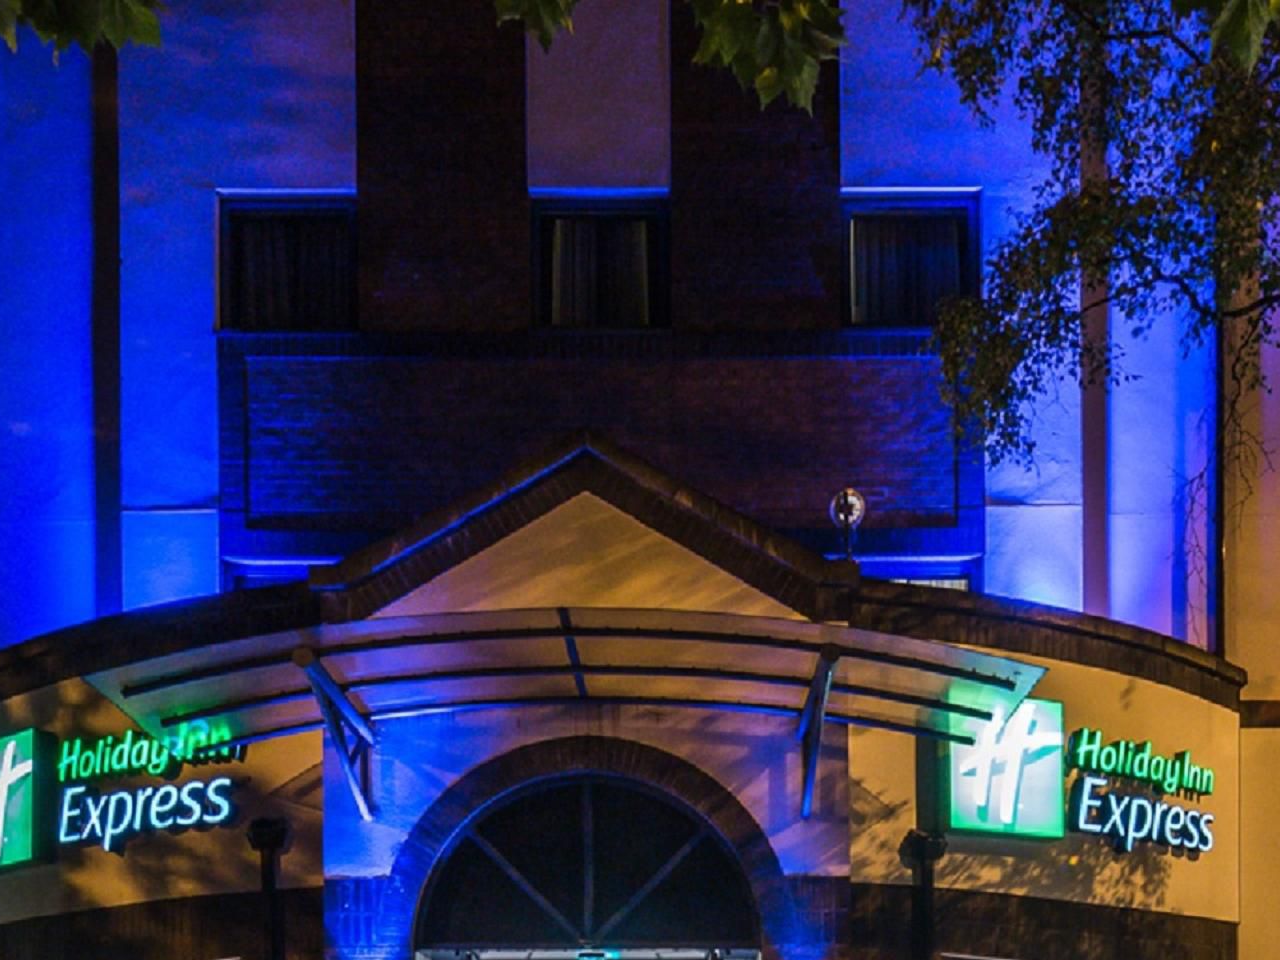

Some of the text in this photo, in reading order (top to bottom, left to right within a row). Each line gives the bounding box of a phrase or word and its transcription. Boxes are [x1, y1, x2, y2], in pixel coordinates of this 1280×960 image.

[57, 729, 169, 782] Holiday
[1077, 728, 1215, 795] Holiday Inn
[59, 777, 232, 852] Express
[1078, 776, 1215, 852] Express
